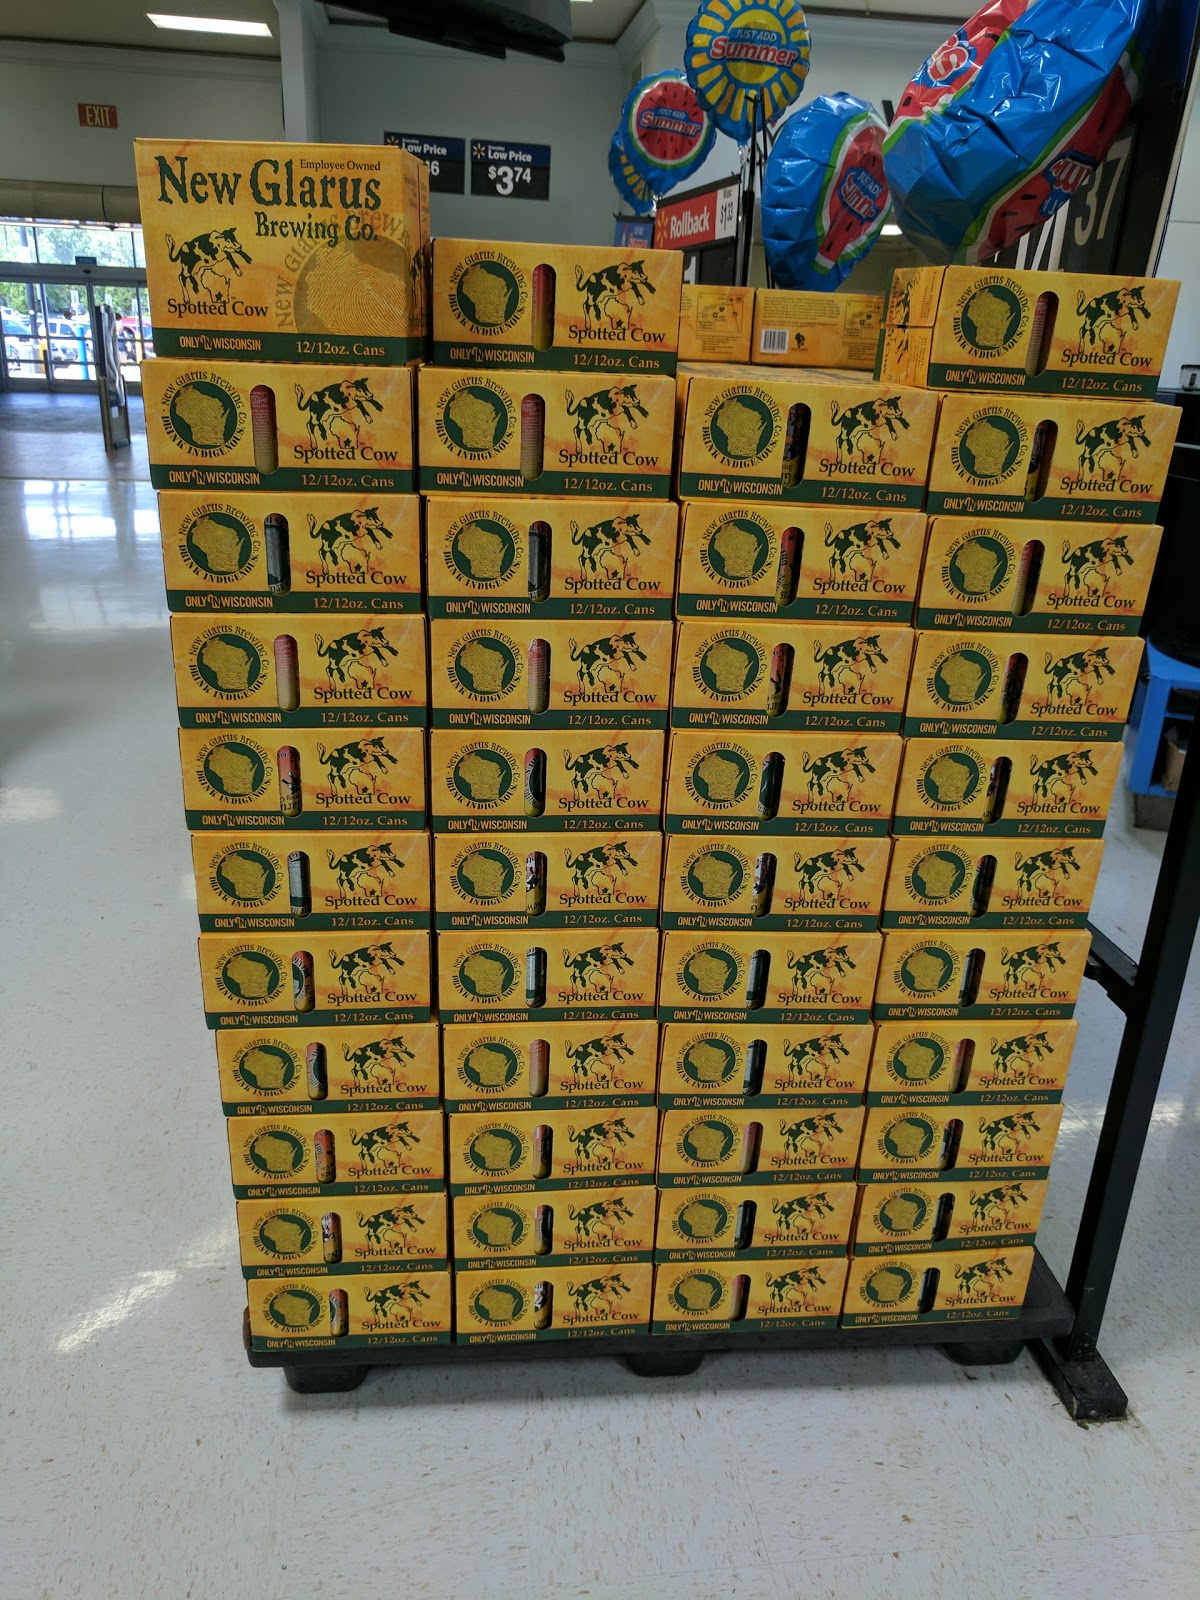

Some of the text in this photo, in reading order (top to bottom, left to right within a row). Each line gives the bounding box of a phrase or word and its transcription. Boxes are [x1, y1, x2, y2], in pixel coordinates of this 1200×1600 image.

[735, 29, 777, 42] JUST ADD
[710, 36, 798, 66] Summer
[86, 105, 110, 126] EXIT
[640, 112, 701, 137] Summer
[423, 144, 447, 156] Price
[488, 149, 532, 163] Low Price
[300, 159, 381, 172] Employee Owned
[154, 155, 242, 205] New
[250, 158, 382, 211] Glarus
[254, 211, 338, 247] Brewing
[344, 214, 379, 242] Co.
[669, 205, 711, 240] Rollback
[167, 298, 269, 319] Spotted Cow
[569, 325, 666, 344] Spotted Cow
[212, 338, 262, 351] WISCONSIN
[295, 341, 386, 357] 12/12oz. Cans
[484, 349, 535, 363] WISCONSIN
[573, 354, 660, 369] 12/12oz. Cans
[1061, 349, 1154, 367] Spotted Cow
[1061, 377, 1143, 392] 12/12oz. Cans
[435, 419, 514, 460] DRINK INDIGENOUS
[294, 445, 398, 464] Spotted Cow
[559, 449, 660, 468] Spotted Cow
[819, 458, 916, 477] Spotted Cow
[301, 474, 394, 487] 12/12oz. Cans
[472, 474, 525, 488] WISCONSIN
[564, 478, 653, 492] 12/12oz. Cans
[1060, 476, 1154, 495] Spotted Cow
[821, 487, 907, 502] 12/12oz. Cans
[1060, 504, 1142, 518] 12/12oz. Cans
[306, 570, 407, 588] Spotted Cow
[565, 576, 661, 594] Spotted Cow
[813, 577, 906, 595] Spotted Cow
[220, 596, 274, 608] WISCONSIN
[1046, 593, 1137, 610] Spotted Cow
[314, 686, 413, 704] Spotted Cow
[564, 690, 657, 707] Spotted Cow
[802, 691, 894, 708] Spotted Cow
[1030, 702, 1118, 718] Spotted Cow
[320, 712, 409, 724] 12/12oz. Cans
[805, 716, 886, 727] 12/12oz. Cans
[1031, 726, 1108, 737] 12/12oz. Cans
[316, 792, 373, 808] Spotted
[376, 793, 411, 804] Cow
[559, 796, 649, 812] Spotted Cow
[792, 799, 882, 815] Spotted Cow
[1016, 801, 1101, 816] Spotted Cow
[563, 819, 644, 830] 12/12oz. Cans
[325, 894, 417, 910] Spotted Cow
[559, 892, 647, 908] Spotted Cow
[784, 897, 871, 912] Spotted Cow
[1001, 895, 1084, 909] Spotted Cow
[786, 918, 863, 929] 12/12oz. Cans
[328, 991, 417, 1007] Spotted Cow
[558, 990, 644, 1005] Spotted Cow
[778, 992, 862, 1006] Spotted Cow
[989, 988, 1070, 1001] Spotted Cow
[333, 1012, 413, 1023] 12/12oz. Cans
[560, 1079, 644, 1094] Spotted Cow
[774, 1078, 855, 1091] Spotted Cow
[979, 1075, 1057, 1089] Spotted Cow
[341, 1083, 427, 1097] Spotted Cow
[771, 1155, 848, 1168] Spotted Cow
[968, 1153, 1044, 1165] Spotted Cow
[348, 1165, 432, 1179] Spotted Cow
[563, 1161, 644, 1175] Spotted Cow
[959, 1222, 1002, 1235] Spotted
[564, 1238, 643, 1252] Spotted Cow
[763, 1232, 840, 1244] Spotted Cow
[355, 1246, 436, 1259] Spotted Cow
[945, 1294, 1016, 1307] Spotted Cow
[757, 1304, 801, 1316] Spotted
[362, 1319, 441, 1332] Spotted Cow
[563, 1312, 608, 1326] Spotted
